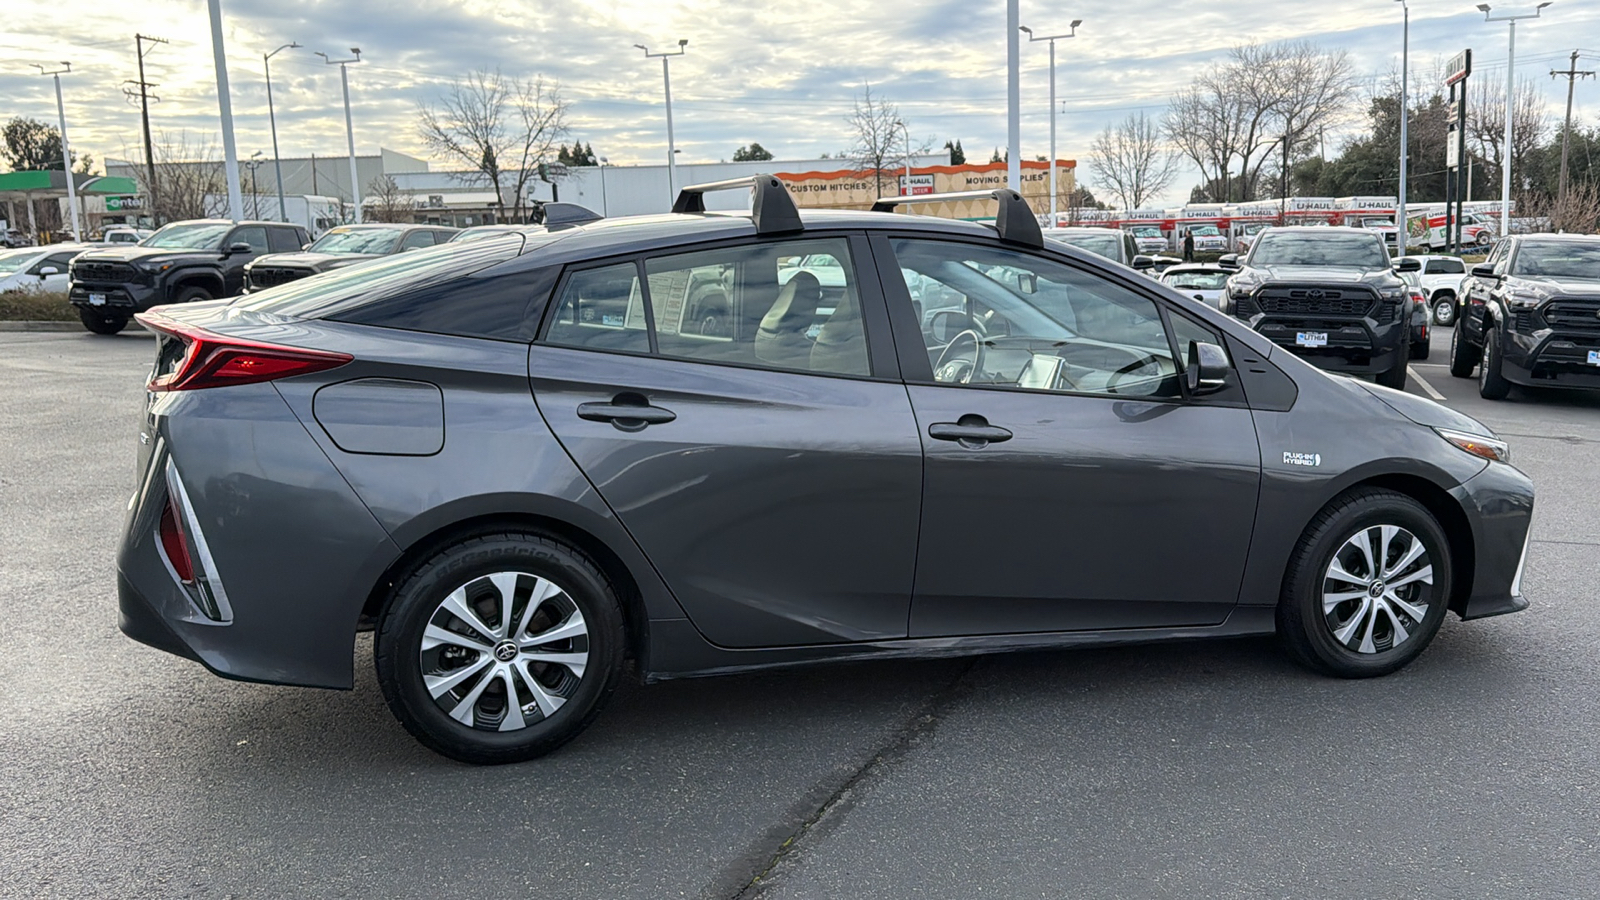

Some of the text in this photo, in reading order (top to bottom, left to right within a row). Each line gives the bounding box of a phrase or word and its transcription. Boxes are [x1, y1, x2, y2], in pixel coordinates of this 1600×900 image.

[966, 173, 1043, 185] MOVING SPLIES
[790, 182, 867, 193] CUSTOM HITCHES
[1297, 202, 1332, 210] U-HAUL
[1283, 451, 1314, 460] PLUG-IN
[1283, 458, 1314, 466] HYBRID
